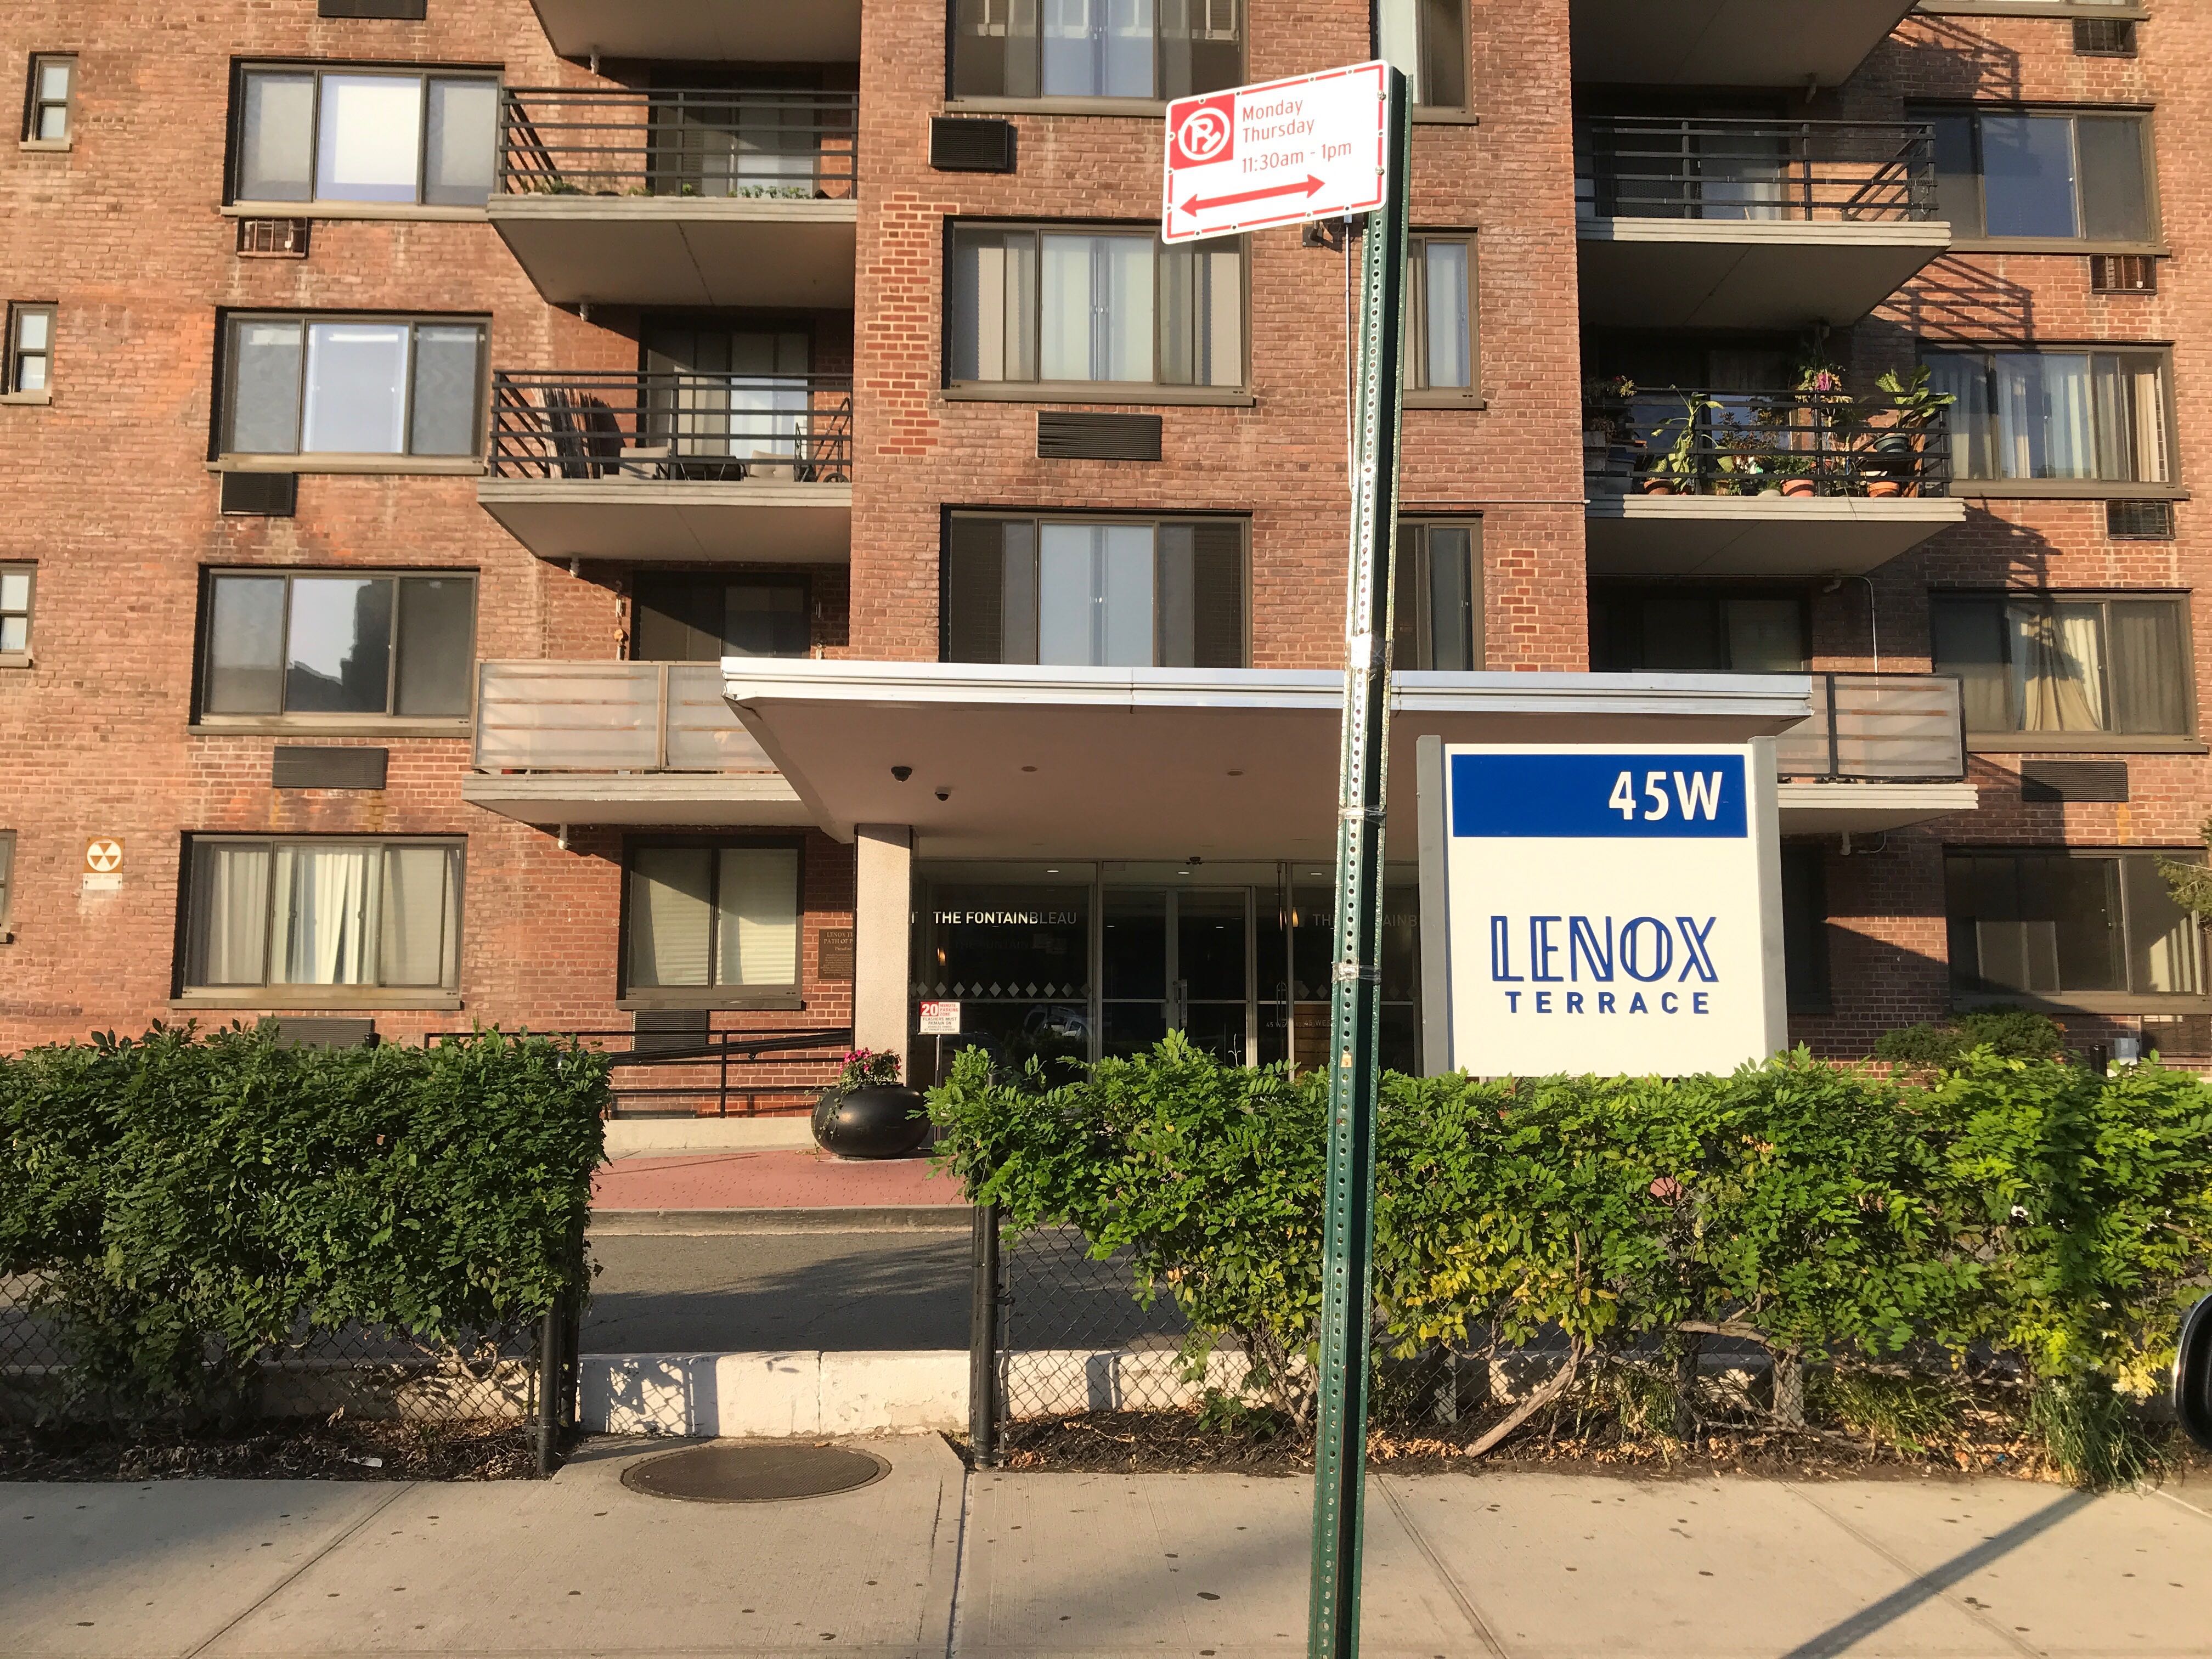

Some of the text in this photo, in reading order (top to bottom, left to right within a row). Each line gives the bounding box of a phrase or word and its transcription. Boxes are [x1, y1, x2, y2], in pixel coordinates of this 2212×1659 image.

[1242, 99, 1304, 122] Monday
[1243, 119, 1315, 143] Thursday
[1242, 150, 1304, 173] 11:30am
[1321, 142, 1352, 162] 1pm
[1609, 771, 1723, 821] 45W
[933, 911, 962, 924] THE
[966, 911, 1077, 924] FONTAINBLEAU
[1312, 914, 1334, 927] TH
[1490, 915, 1719, 983] LENOX
[921, 1004, 938, 1016] 20
[1505, 991, 1709, 1014] TERRACE
